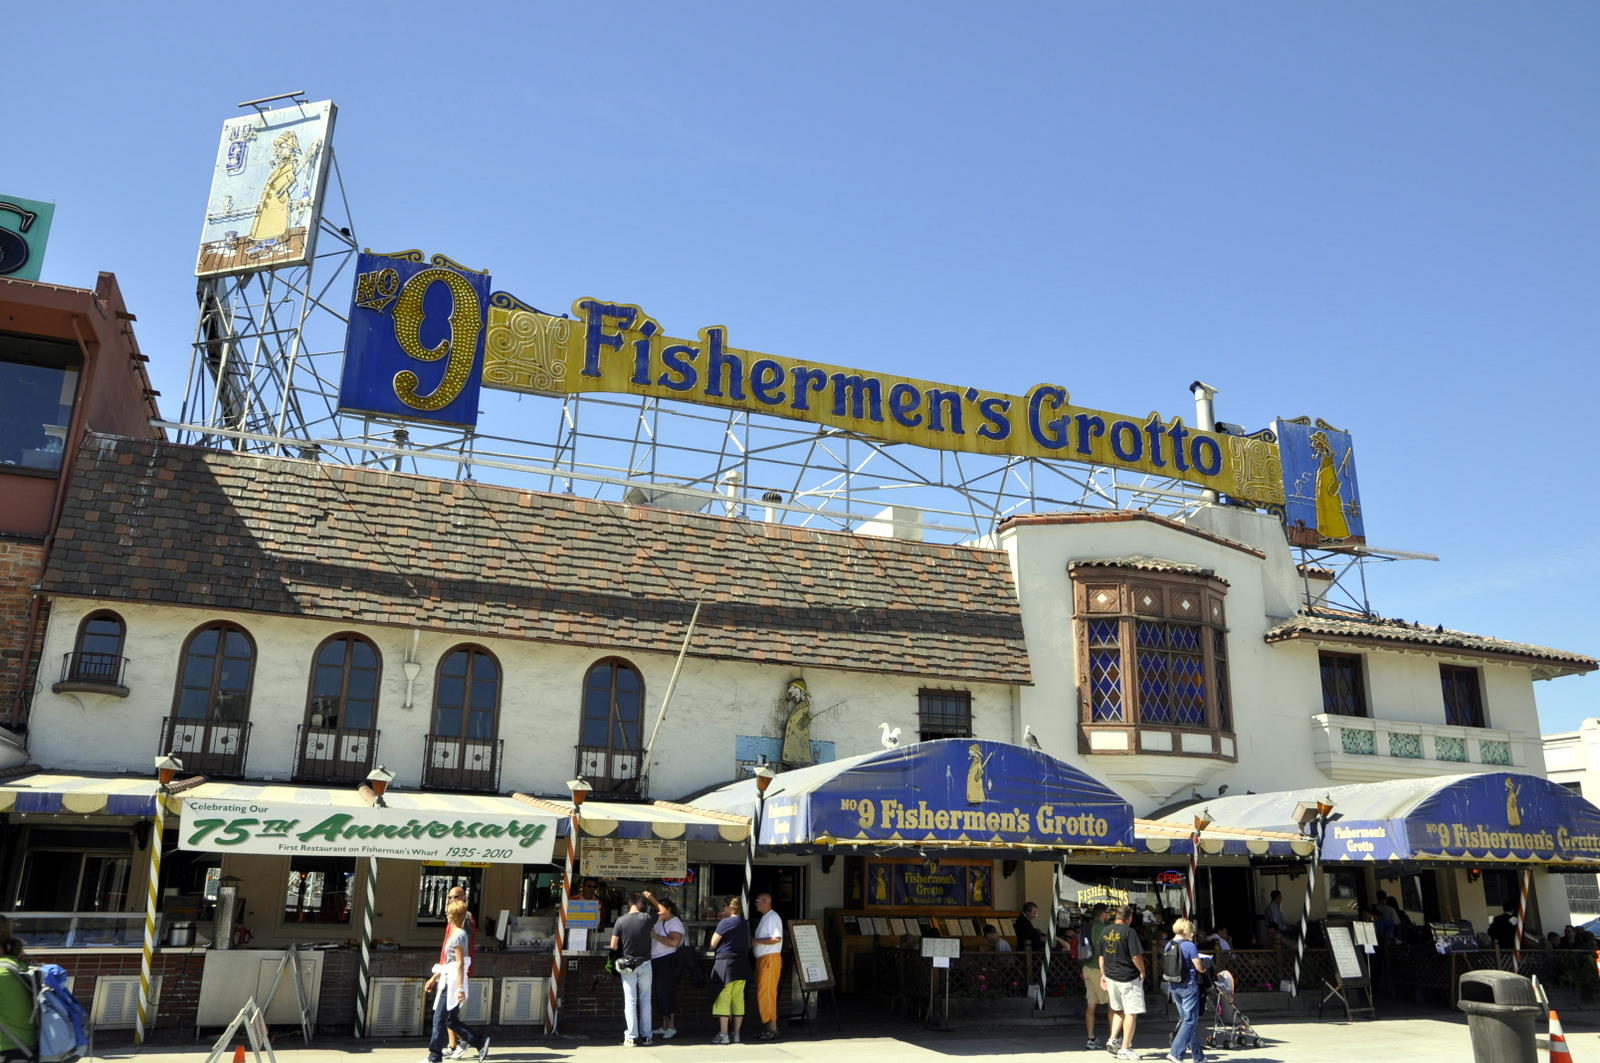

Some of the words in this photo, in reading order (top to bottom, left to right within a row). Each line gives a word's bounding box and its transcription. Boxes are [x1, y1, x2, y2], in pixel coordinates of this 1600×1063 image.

[225, 140, 248, 176] 9
[355, 267, 400, 305] NO
[391, 267, 485, 411] 9
[578, 299, 1012, 442] Fishermen's
[1028, 384, 1223, 478] Grotto
[190, 802, 247, 814] Celebrating
[249, 804, 269, 814] Our
[840, 798, 857, 811] NO
[857, 798, 875, 829] 9
[880, 799, 1031, 833] Fishermen's
[1035, 805, 1109, 838] Grotto
[296, 813, 548, 849] Anniversary
[1346, 839, 1375, 853] Grotto
[1438, 823, 1450, 848] 9
[1452, 823, 1555, 850] Fishermen's
[278, 843, 298, 851] First
[300, 844, 347, 852] Restaurant
[361, 846, 410, 855] Fisherman's
[412, 849, 439, 857] Wharf
[916, 884, 944, 896] Grotto
